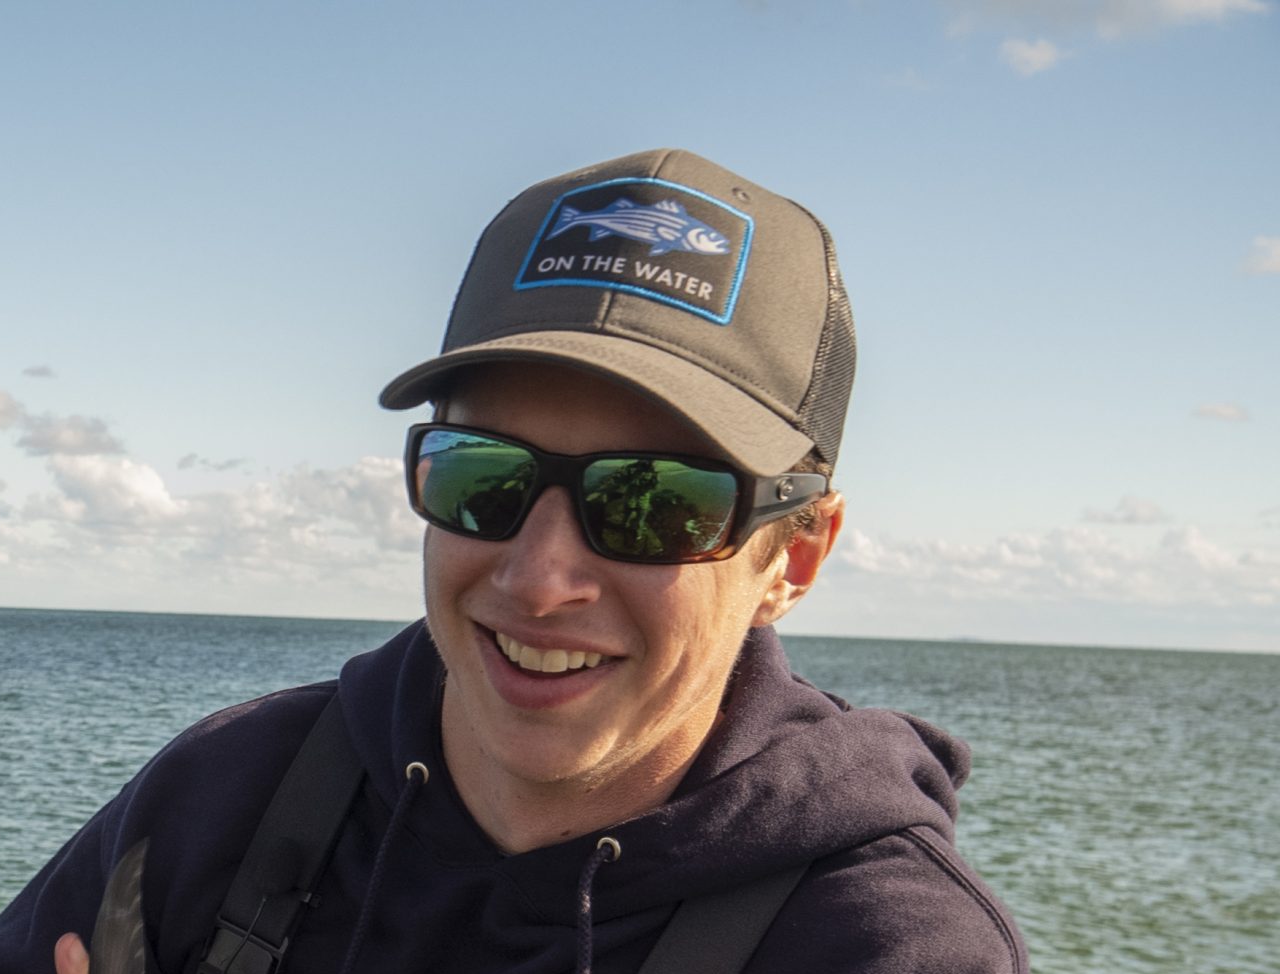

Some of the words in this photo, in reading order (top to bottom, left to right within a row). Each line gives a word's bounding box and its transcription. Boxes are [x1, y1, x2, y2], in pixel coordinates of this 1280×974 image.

[537, 255, 576, 273] ON
[582, 255, 627, 274] THE
[634, 261, 713, 300] WATER
